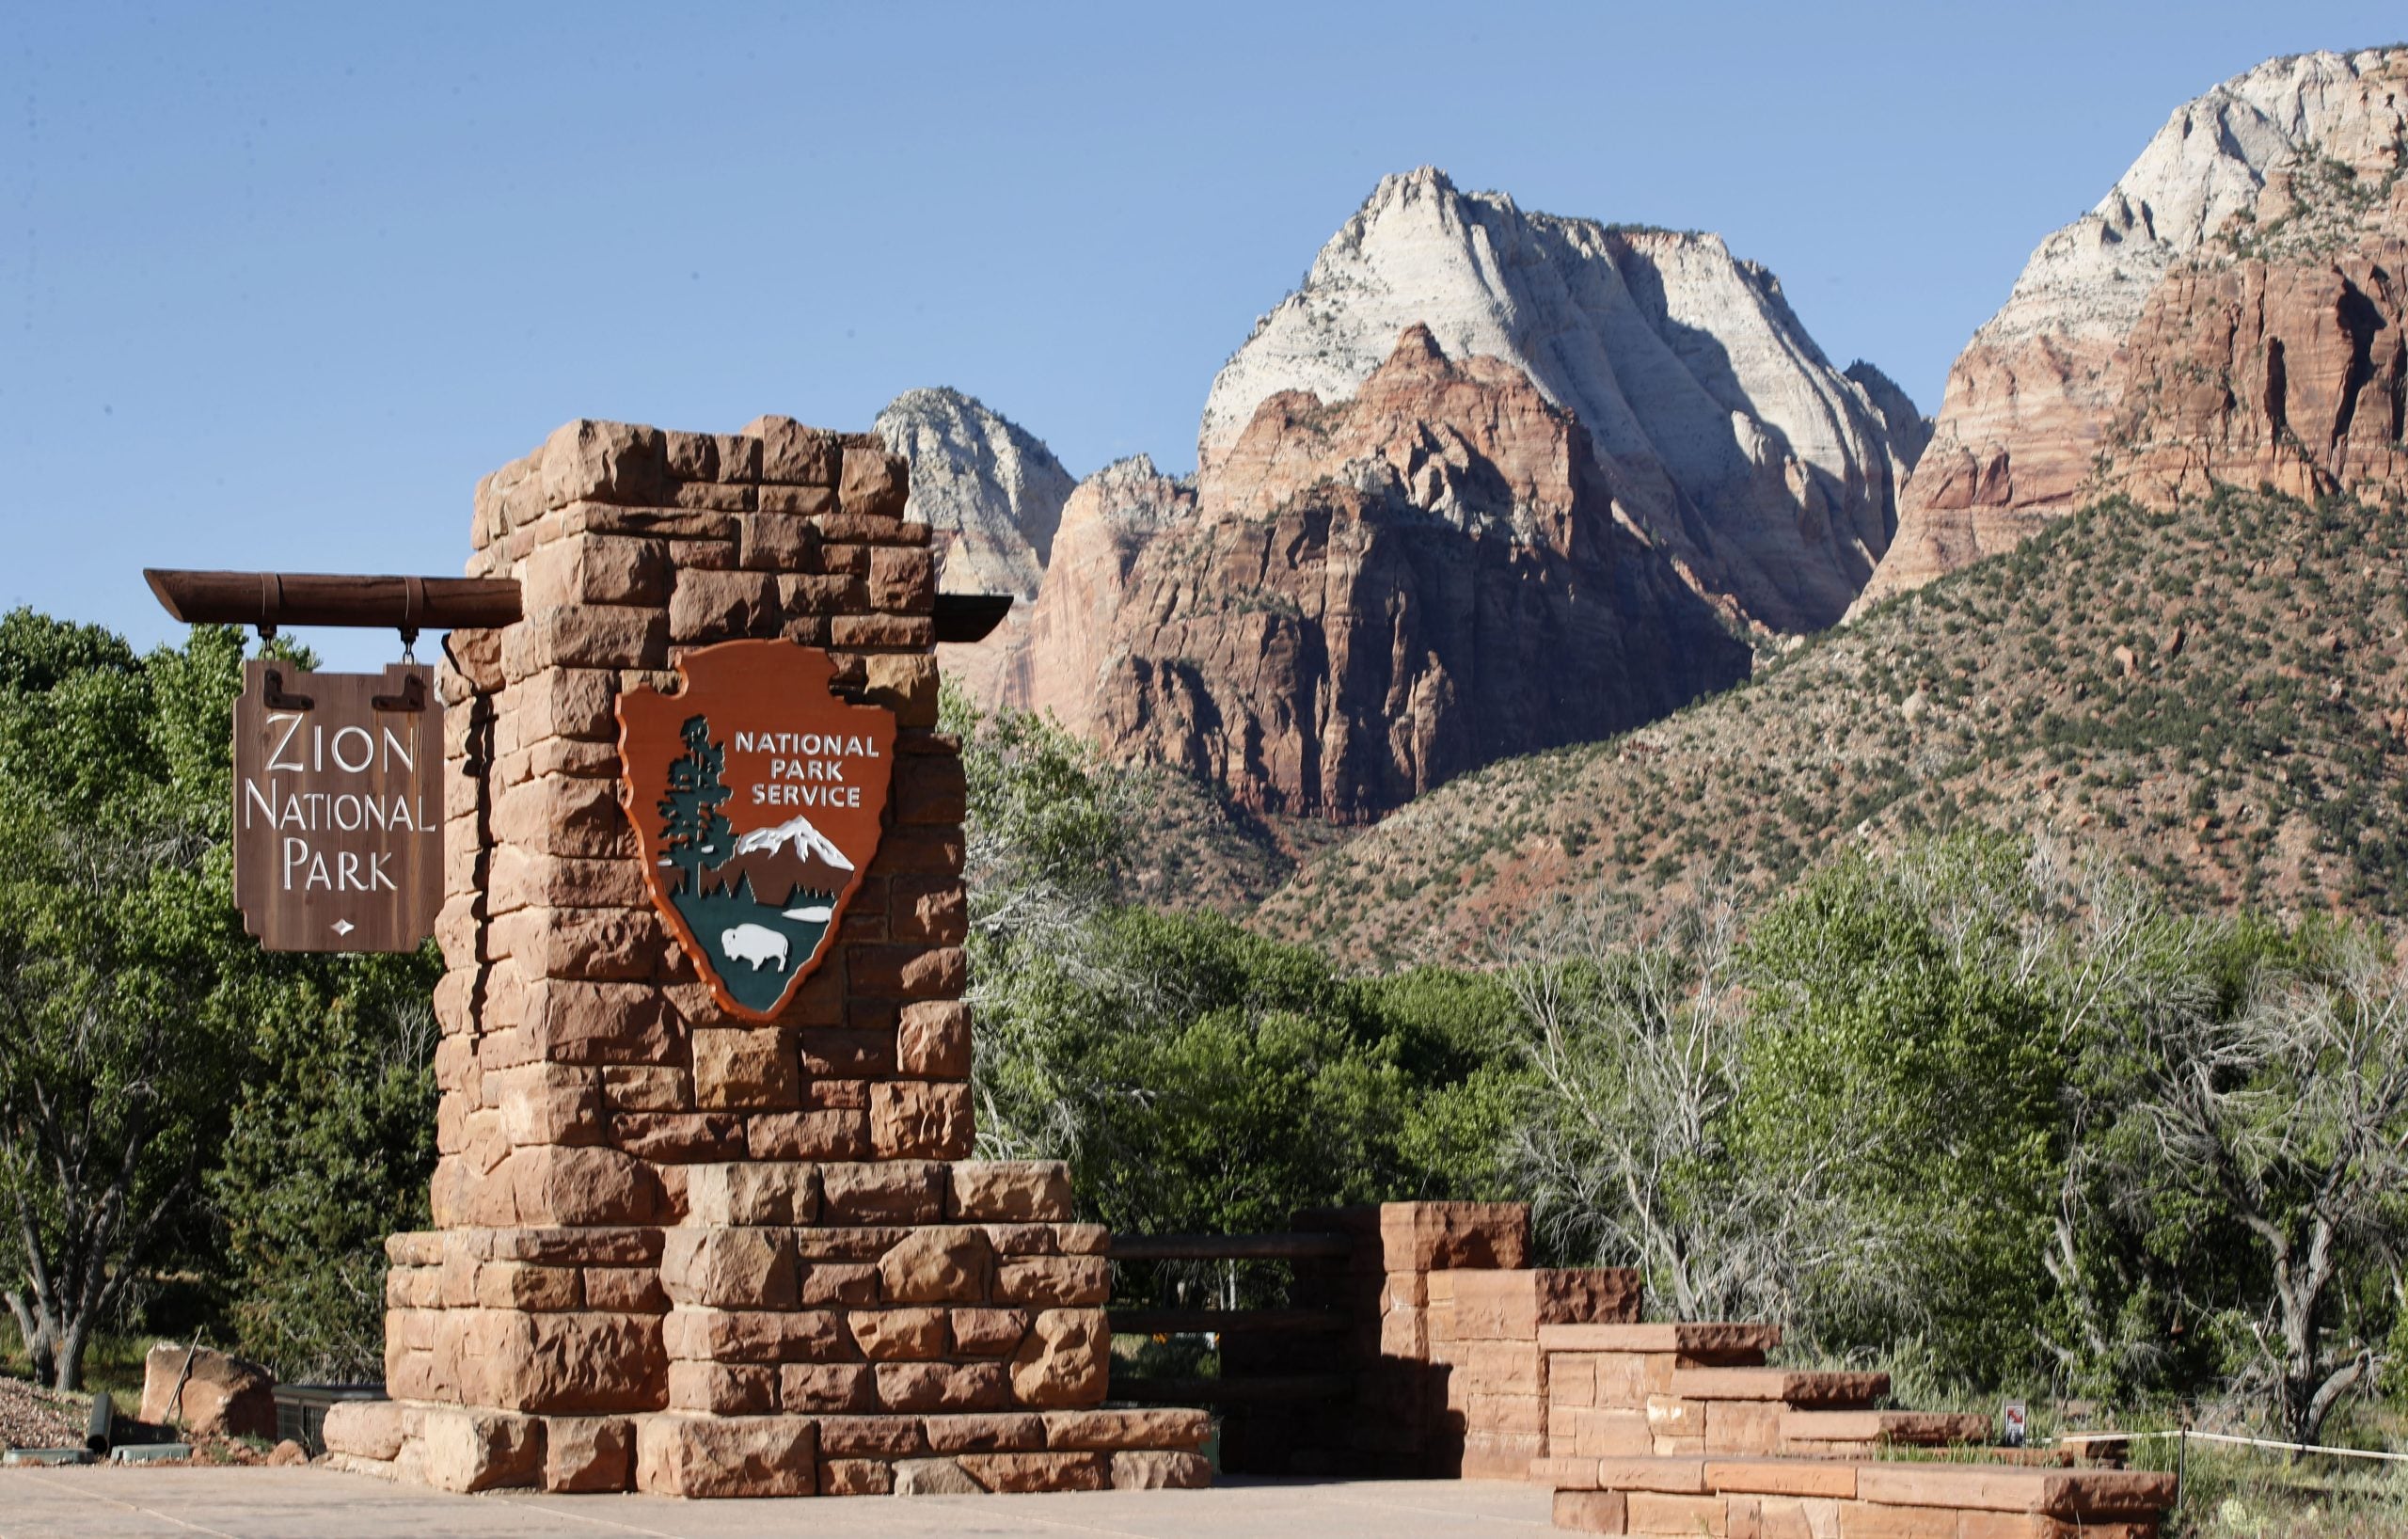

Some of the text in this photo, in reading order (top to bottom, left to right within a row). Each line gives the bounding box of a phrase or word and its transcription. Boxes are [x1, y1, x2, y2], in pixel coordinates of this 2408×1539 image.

[264, 712, 413, 773] ZION
[735, 731, 879, 758] NATIONAL
[770, 758, 844, 782] PARK
[245, 777, 436, 832] NATIONAL
[752, 783, 861, 808] SERVICE
[283, 836, 398, 892] PARK
